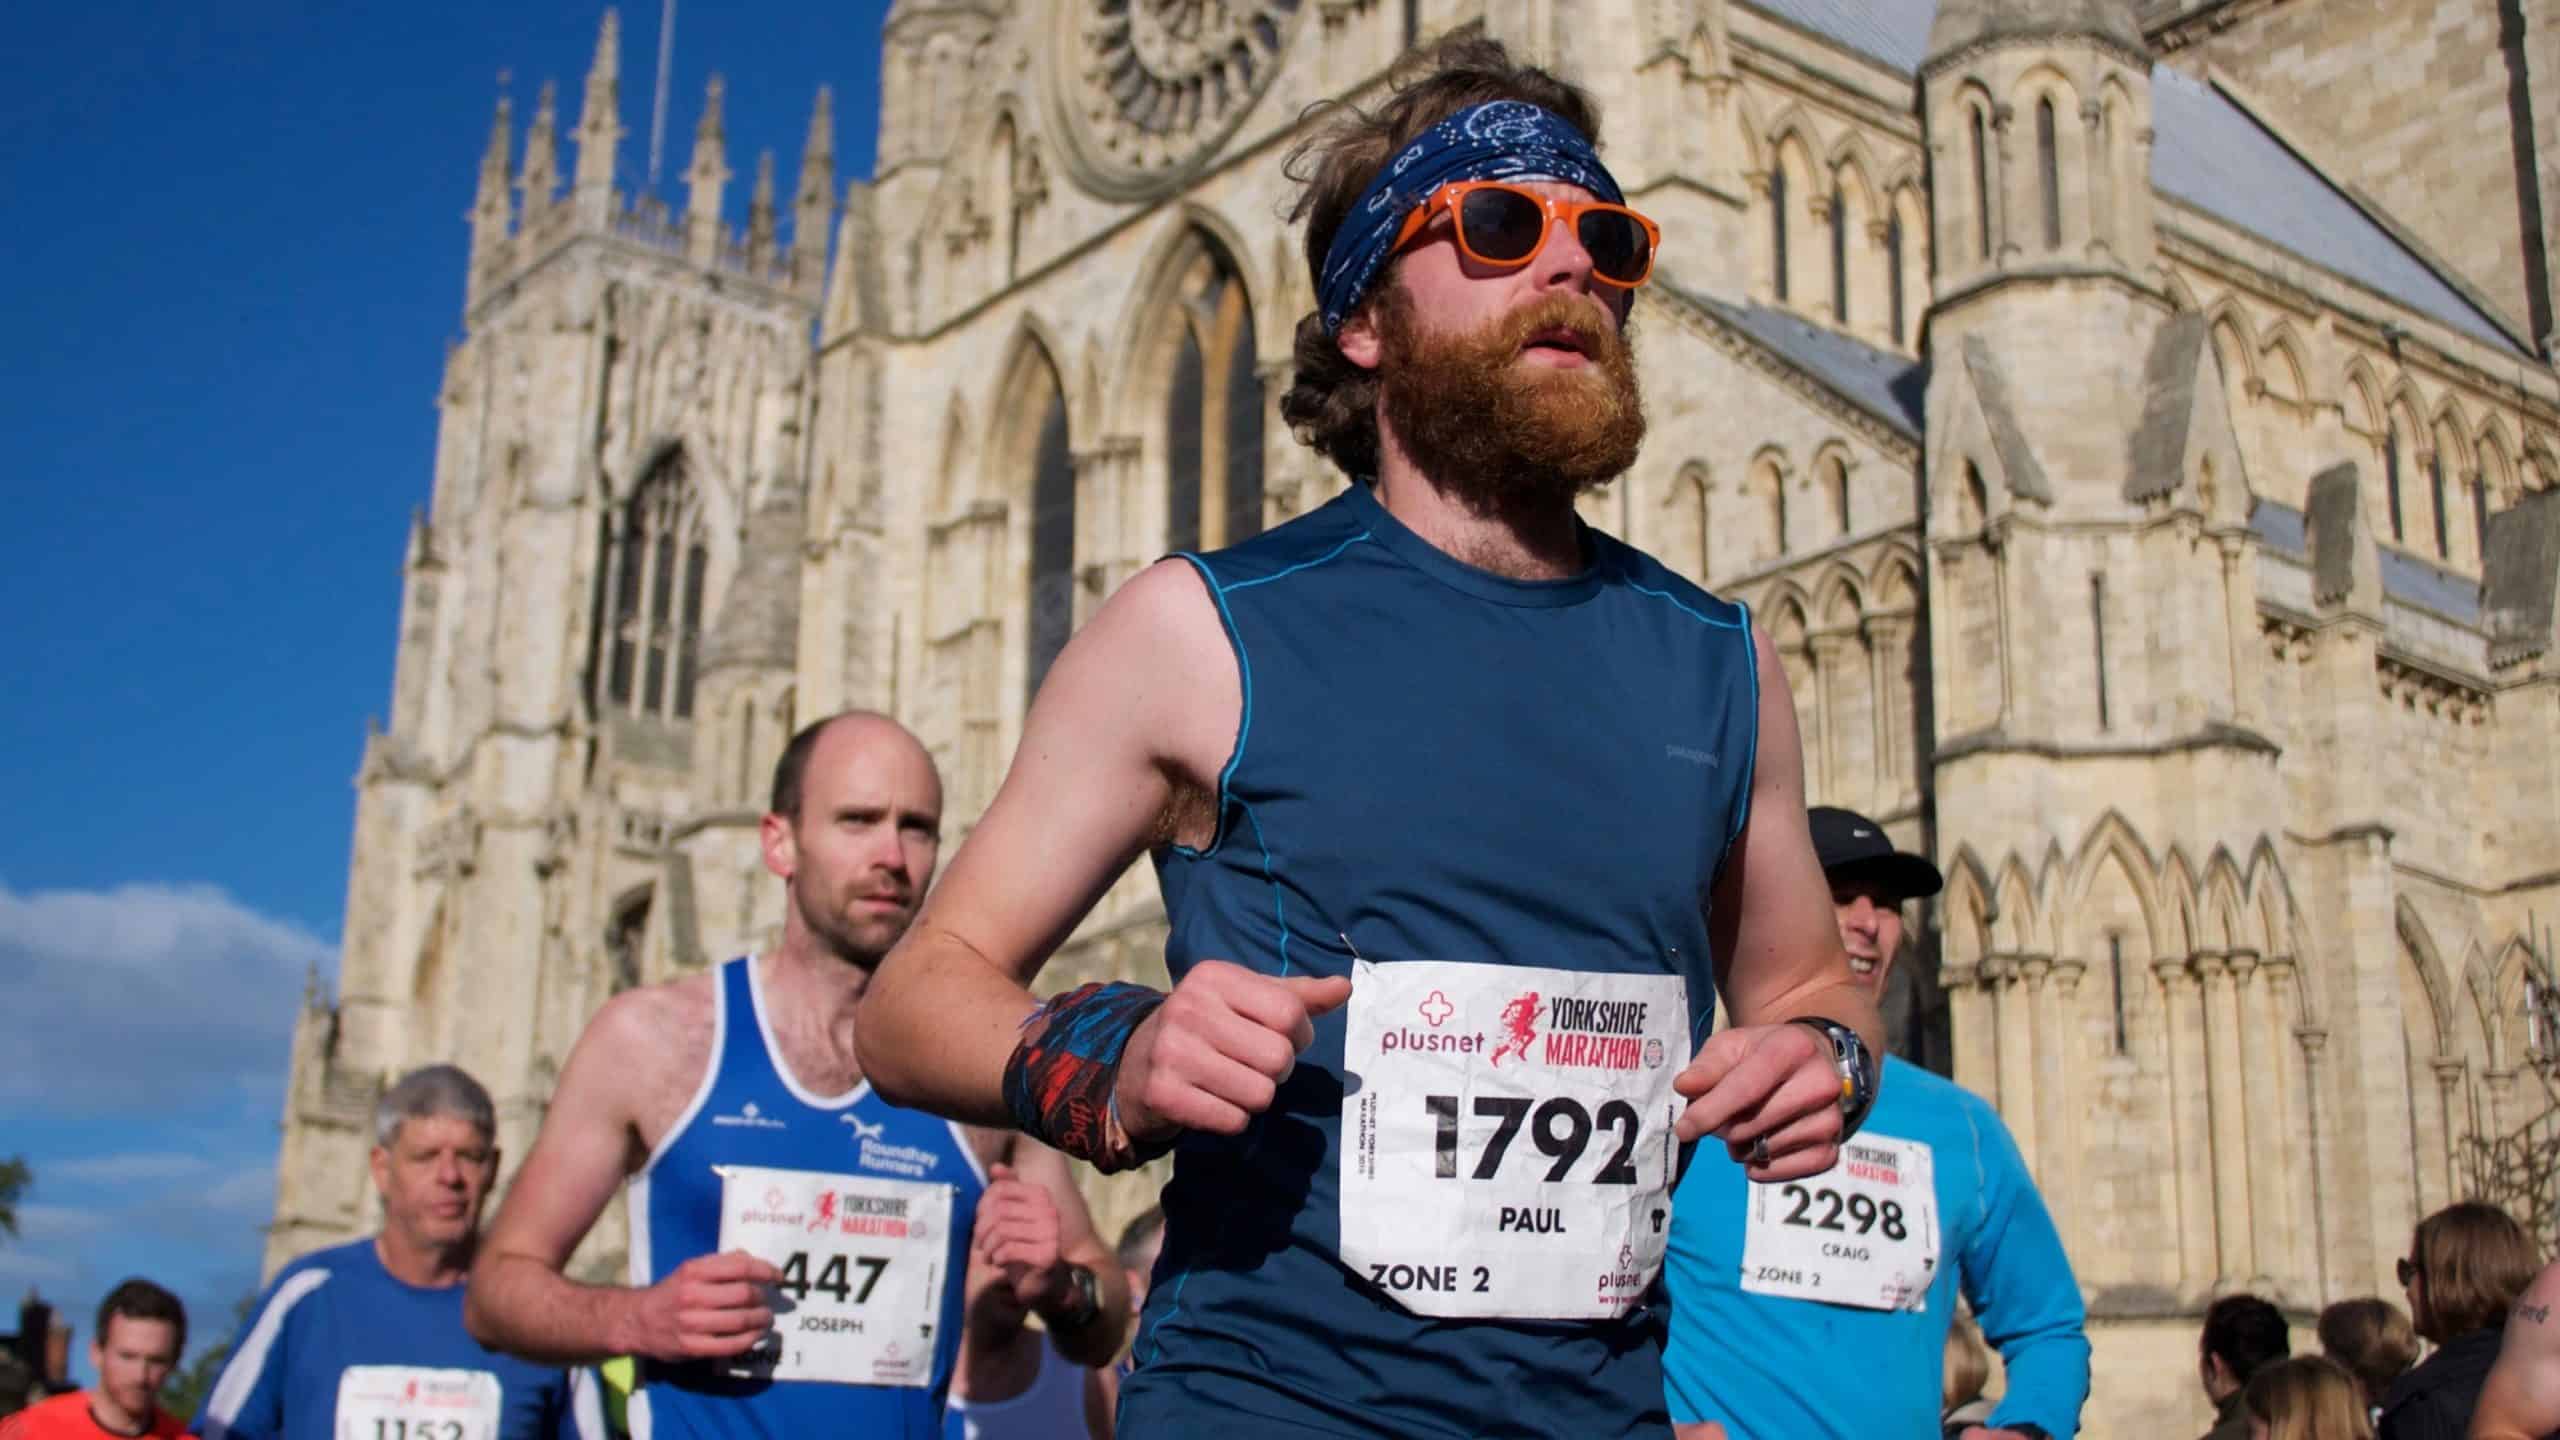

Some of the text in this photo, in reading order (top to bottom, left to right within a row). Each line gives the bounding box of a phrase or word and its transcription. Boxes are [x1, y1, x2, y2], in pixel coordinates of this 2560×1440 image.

[1550, 997, 1648, 1034] YORKSHIRE
[1381, 1026, 1485, 1054] plusnet
[1544, 1033, 1642, 1071] MARATHON
[1424, 1095, 1640, 1185] 1792
[1499, 1207, 1566, 1234] PAUL
[1781, 1184, 1908, 1241] 2298
[1821, 1242, 1871, 1261] CRAIG
[1369, 1263, 1490, 1292] ZONE 2
[1758, 1266, 1822, 1287] ZONE 2
[799, 1316, 864, 1334] JOSEPH
